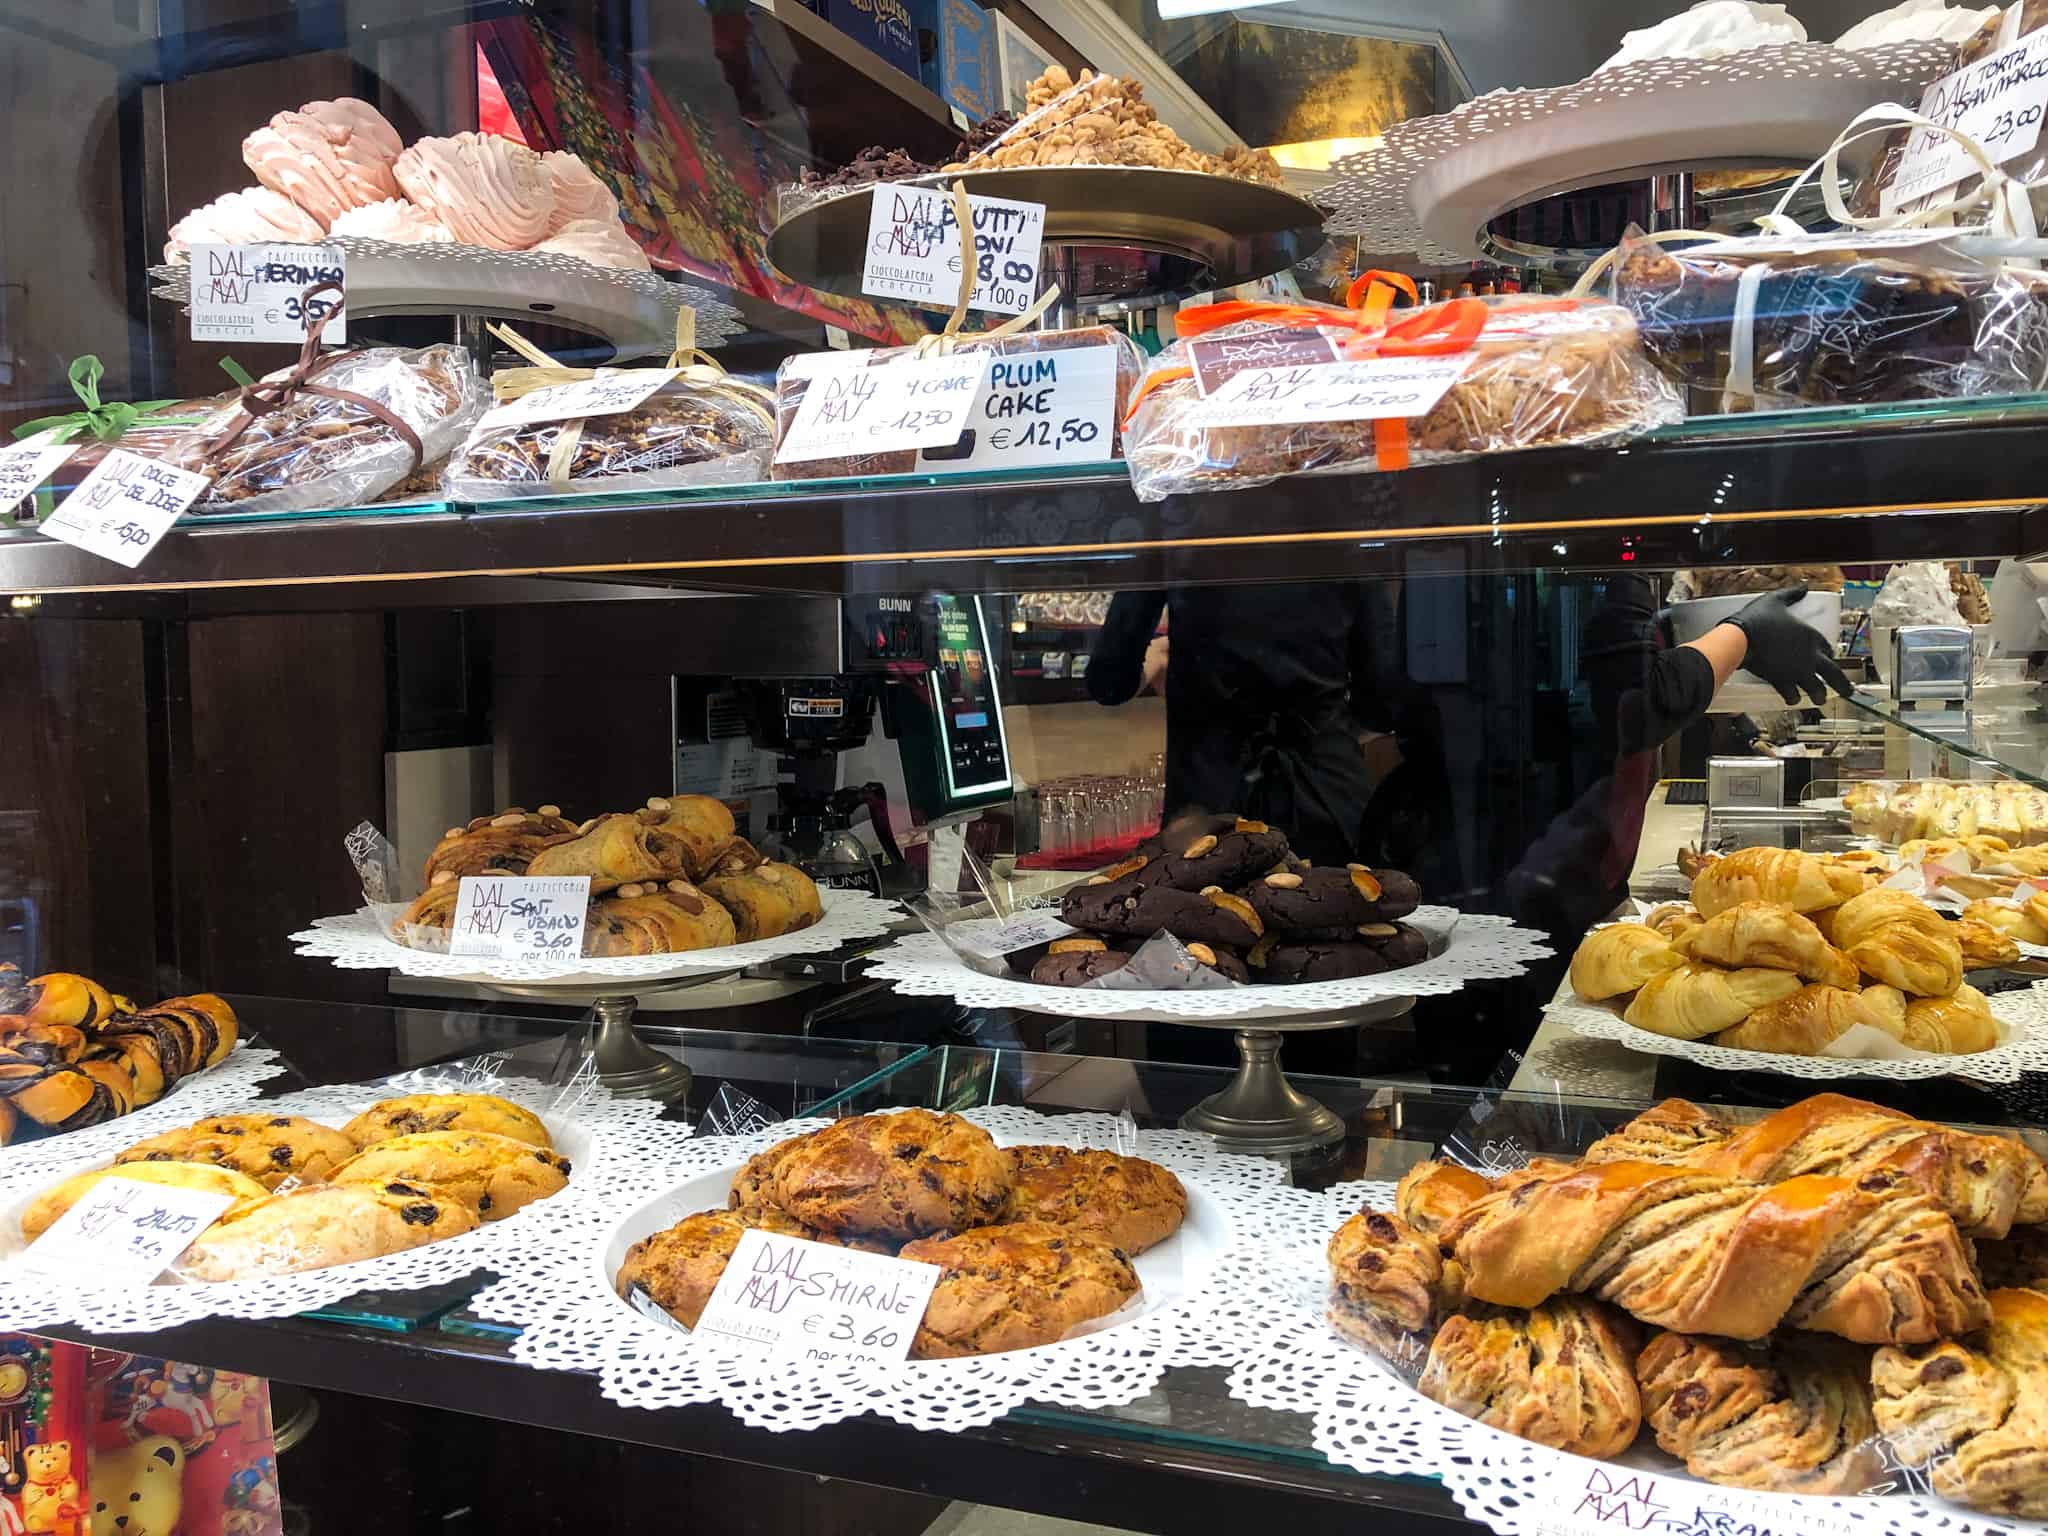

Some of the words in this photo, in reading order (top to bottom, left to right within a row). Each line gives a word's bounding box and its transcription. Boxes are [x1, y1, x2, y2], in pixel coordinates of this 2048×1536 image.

[1978, 47, 2027, 84] TORTA
[1984, 104, 2042, 144] 23,00
[940, 198, 1026, 234] BUTTI
[209, 250, 254, 277] DAL
[209, 278, 254, 305] MAS
[988, 286, 1015, 304] 100
[1018, 293, 1029, 312] g
[264, 308, 280, 325] €
[991, 358, 1057, 391] PLUM
[984, 387, 1056, 420] CAKE
[889, 408, 953, 435] 12,50
[988, 427, 1013, 450] €
[1013, 418, 1099, 451] 12,50
[140, 464, 181, 488] DOLCE
[124, 483, 144, 502] DEL
[879, 597, 912, 613] BUNN
[472, 883, 510, 908] DAL
[468, 908, 511, 937] MAS
[752, 1241, 807, 1282] DAL
[735, 1274, 804, 1314] MAS
[800, 1271, 917, 1315] SMIRNE
[802, 1314, 825, 1334] €
[1585, 1467, 1671, 1509] DAL
[1572, 1492, 1671, 1530] MAS
